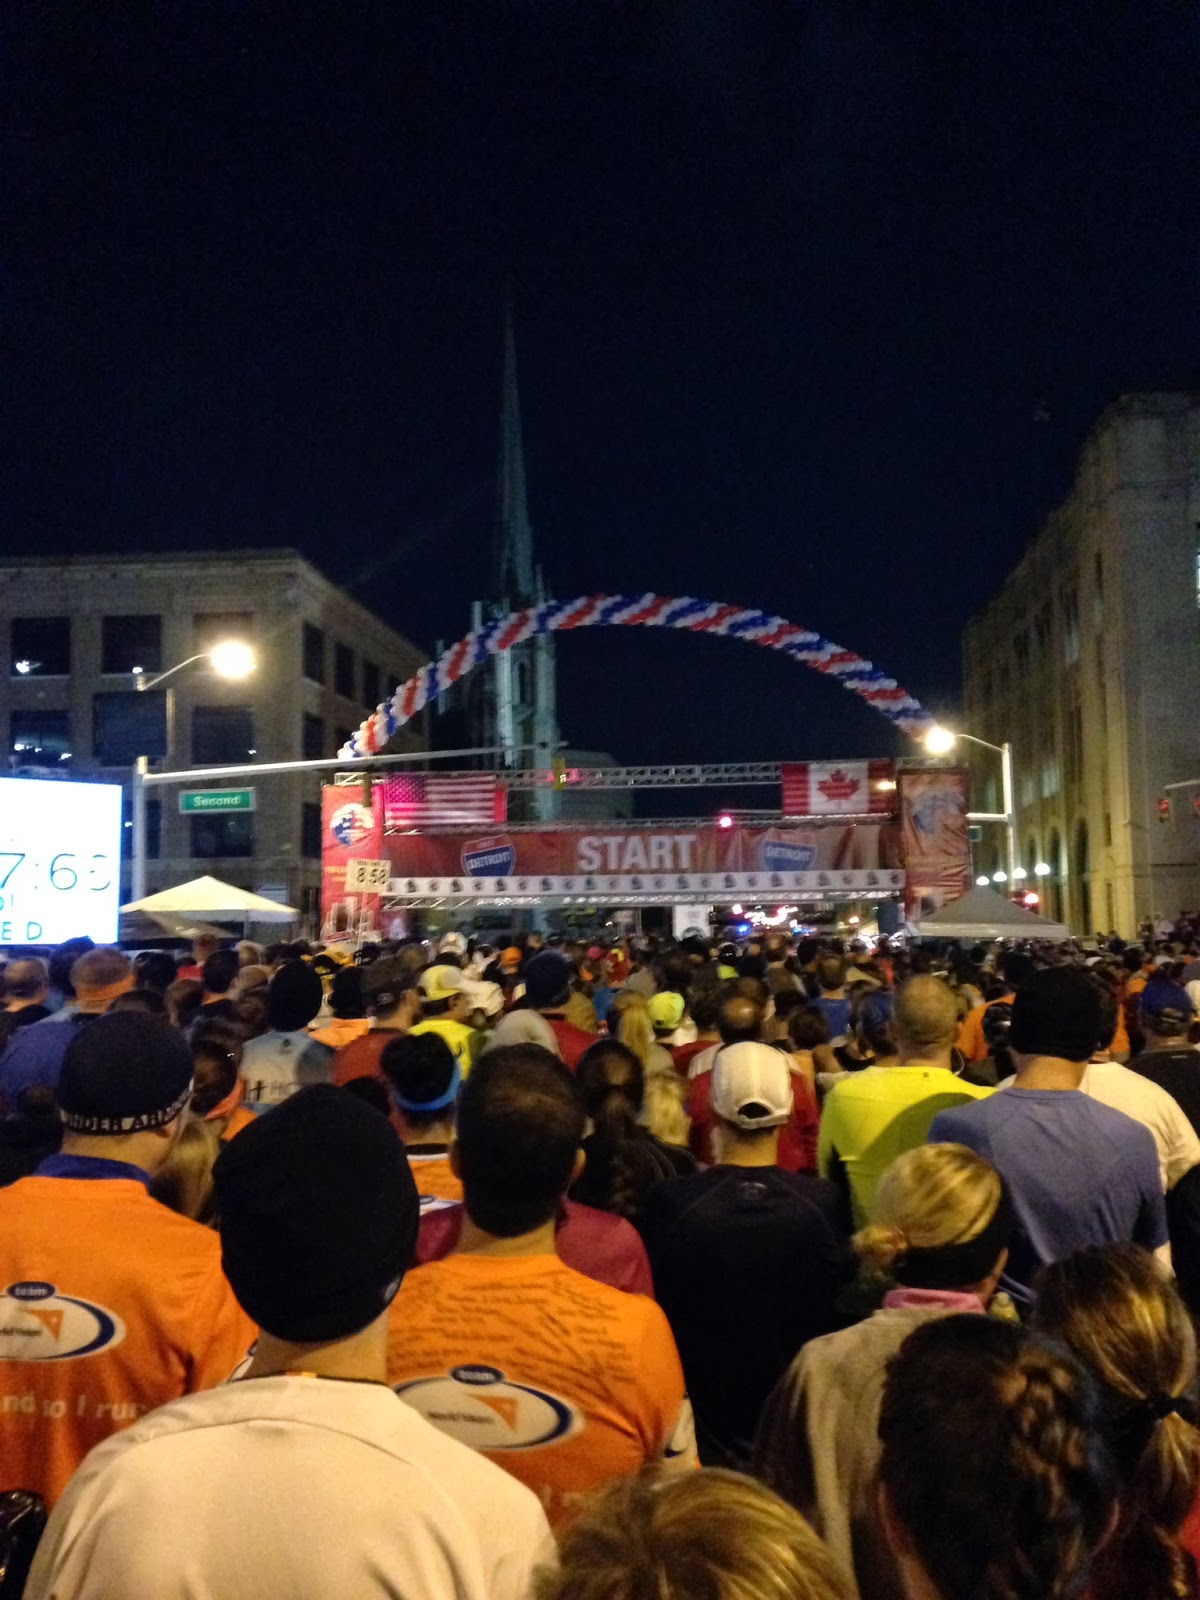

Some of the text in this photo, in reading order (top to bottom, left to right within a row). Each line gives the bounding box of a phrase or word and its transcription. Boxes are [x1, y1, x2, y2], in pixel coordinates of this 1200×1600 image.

[193, 795, 242, 807] Second
[469, 851, 511, 870] DETROIT
[577, 834, 697, 873] START
[766, 846, 813, 861] DETROIT
[14, 1286, 49, 1297] team
[42, 1399, 67, 1419] so
